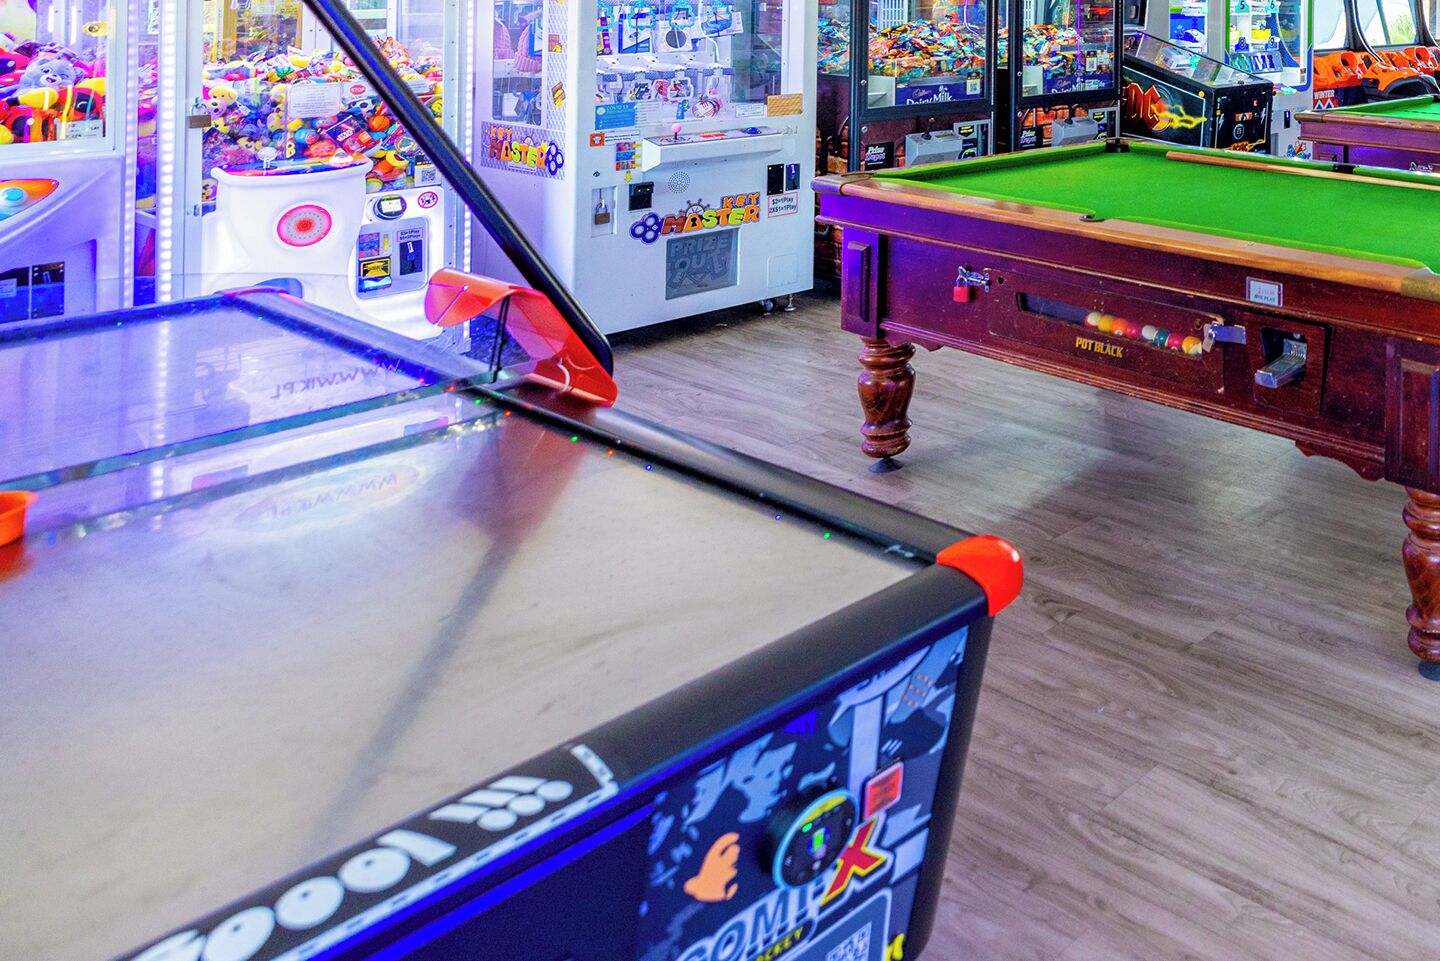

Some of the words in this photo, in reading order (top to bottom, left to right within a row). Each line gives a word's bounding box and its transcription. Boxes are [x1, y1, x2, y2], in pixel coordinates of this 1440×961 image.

[351, 85, 366, 94] STOP
[933, 92, 953, 103] Milk
[1314, 89, 1335, 99] WINTER
[489, 139, 547, 170] MASTER
[721, 192, 760, 209] KEY
[661, 205, 760, 235] MASTER
[671, 233, 729, 257] PRIZE
[1075, 337, 1094, 350] POT
[1094, 341, 1123, 358] BLACK
